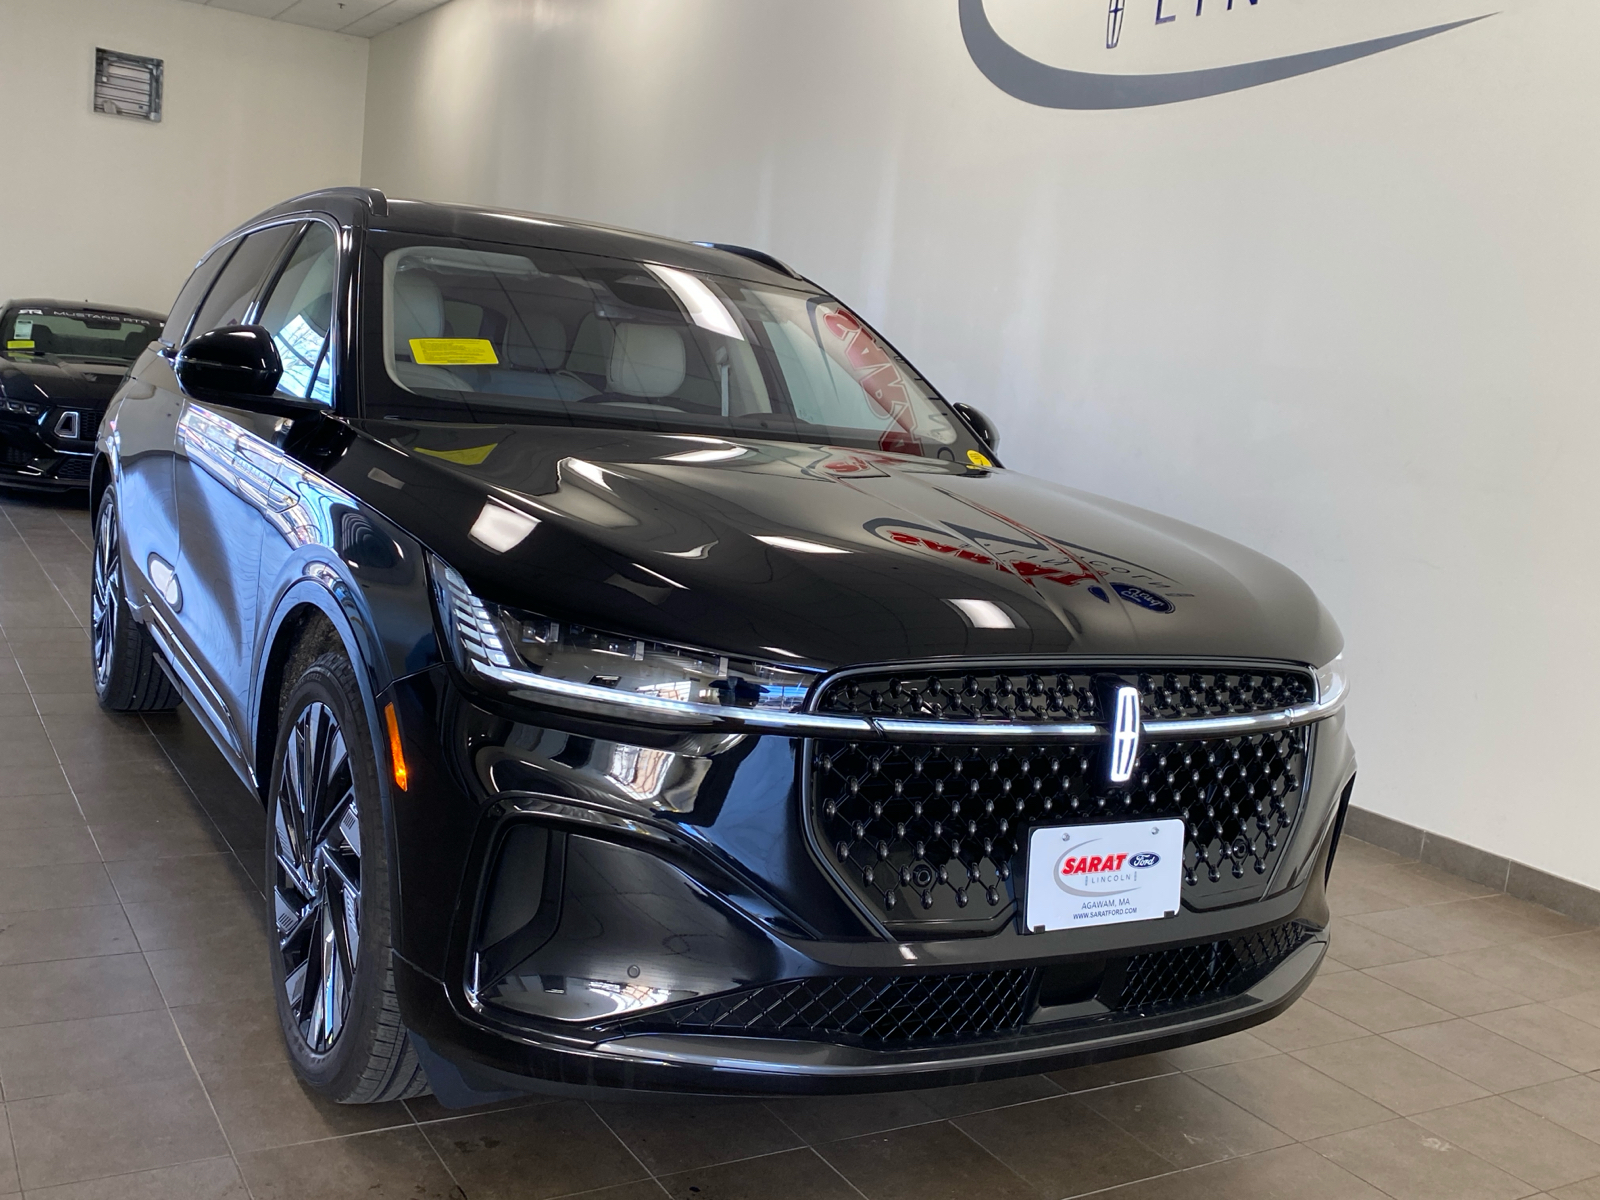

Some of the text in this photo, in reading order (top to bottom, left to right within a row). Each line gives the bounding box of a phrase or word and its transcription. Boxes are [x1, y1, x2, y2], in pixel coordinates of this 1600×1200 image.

[53, 311, 150, 325] MUSTANG RTR
[1062, 853, 1156, 875] SARAT Ford
[1091, 874, 1131, 884] LINCOLN
[1081, 898, 1131, 910] AGAWAM, MA
[1073, 908, 1137, 919] WWW.SARATFORD.COM
